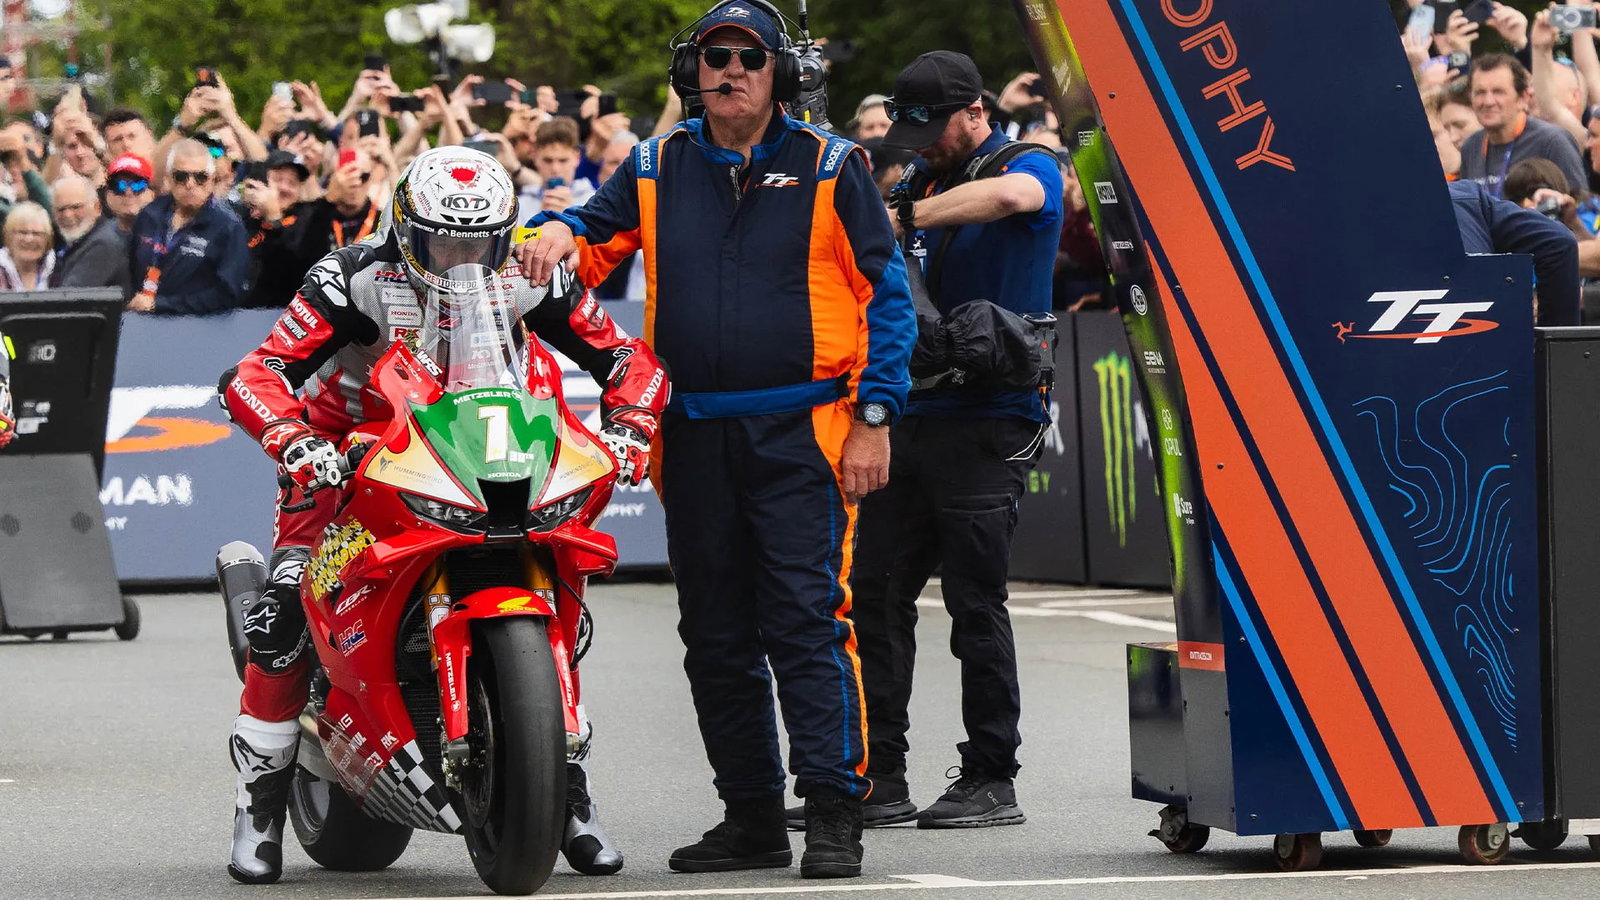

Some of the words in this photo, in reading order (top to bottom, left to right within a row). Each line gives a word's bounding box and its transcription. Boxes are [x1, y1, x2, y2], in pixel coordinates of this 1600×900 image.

[824, 142, 846, 171] sparco
[762, 173, 799, 187] TT
[449, 196, 486, 209] KYT
[450, 230, 490, 238] Bennetts
[291, 298, 318, 329] MOTUL
[1367, 289, 1495, 344] TT
[1144, 351, 1165, 366] SENA
[231, 377, 280, 423] HONDA
[453, 391, 512, 405] METZELER
[477, 405, 510, 464] 1
[445, 652, 457, 701] METZELER
[380, 731, 398, 749] RK
